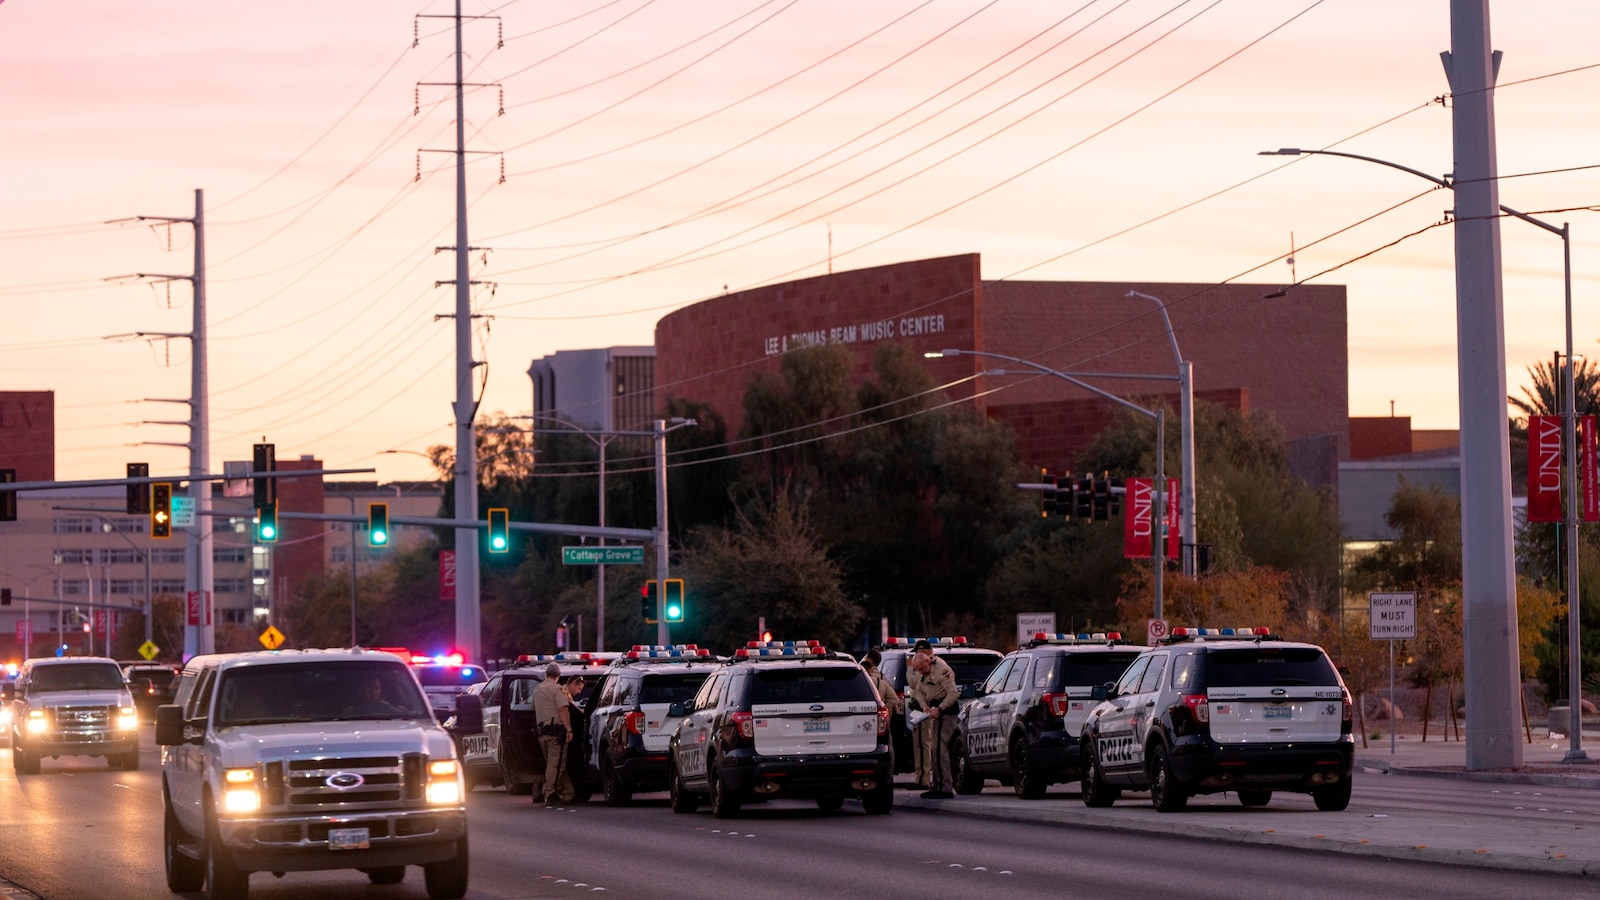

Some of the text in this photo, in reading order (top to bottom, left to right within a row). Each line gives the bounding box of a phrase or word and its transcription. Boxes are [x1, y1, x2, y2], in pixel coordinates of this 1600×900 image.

[765, 336, 779, 355] LEE
[782, 335, 788, 352] &
[830, 325, 857, 345] BEAM
[861, 319, 894, 341] MUSIC
[900, 314, 944, 336] CENTER
[1539, 417, 1561, 494] UNLV
[1134, 479, 1152, 538] UNLV
[570, 550, 603, 563] Cottage
[606, 550, 631, 560] Grove
[1373, 598, 1413, 607] RIGHT LANE
[1381, 611, 1405, 621] MUST
[1373, 625, 1413, 633] TURN RIGHT
[464, 737, 489, 755] POLICE
[969, 732, 998, 754] POLICE
[1100, 738, 1133, 762] POLICE
[681, 750, 700, 773] POLICE
